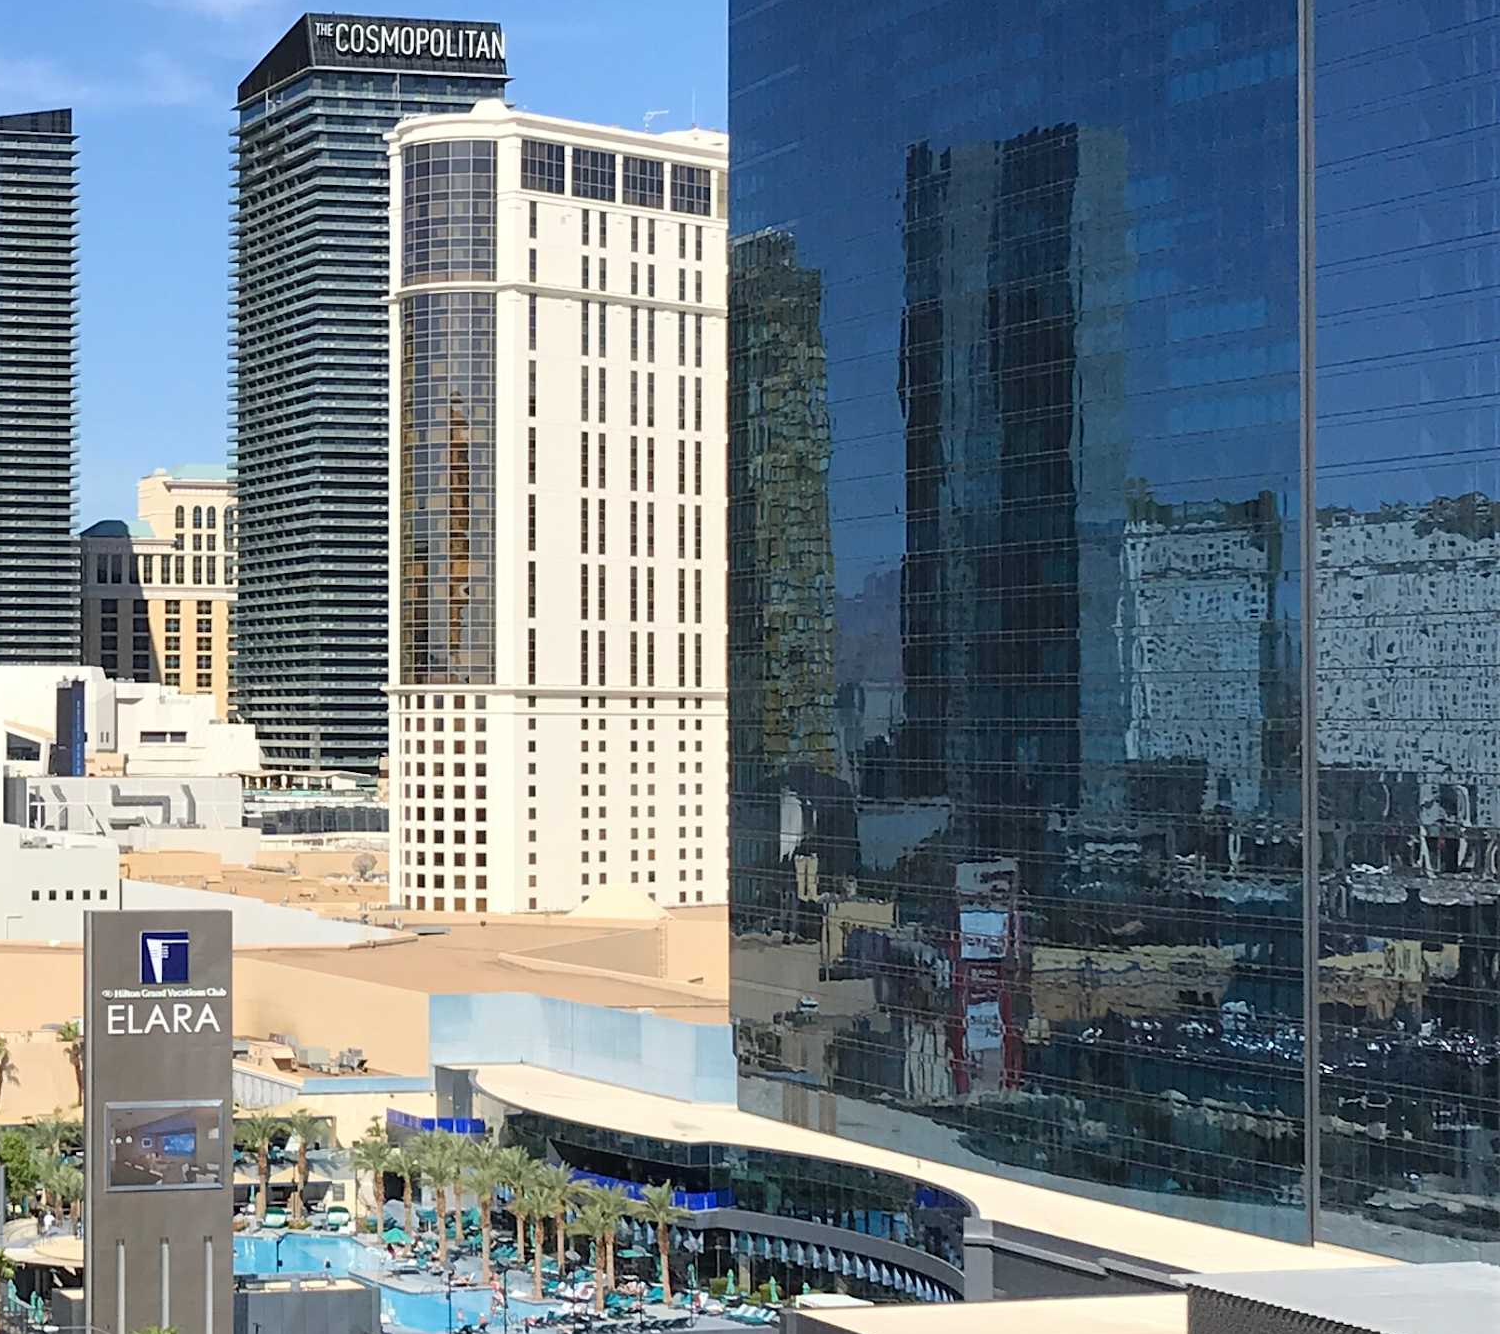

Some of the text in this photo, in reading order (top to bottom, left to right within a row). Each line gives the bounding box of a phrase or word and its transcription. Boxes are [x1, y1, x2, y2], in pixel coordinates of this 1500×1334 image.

[315, 22, 506, 60] THE COSMOPOLITAN
[107, 1002, 221, 1035] ELARA
